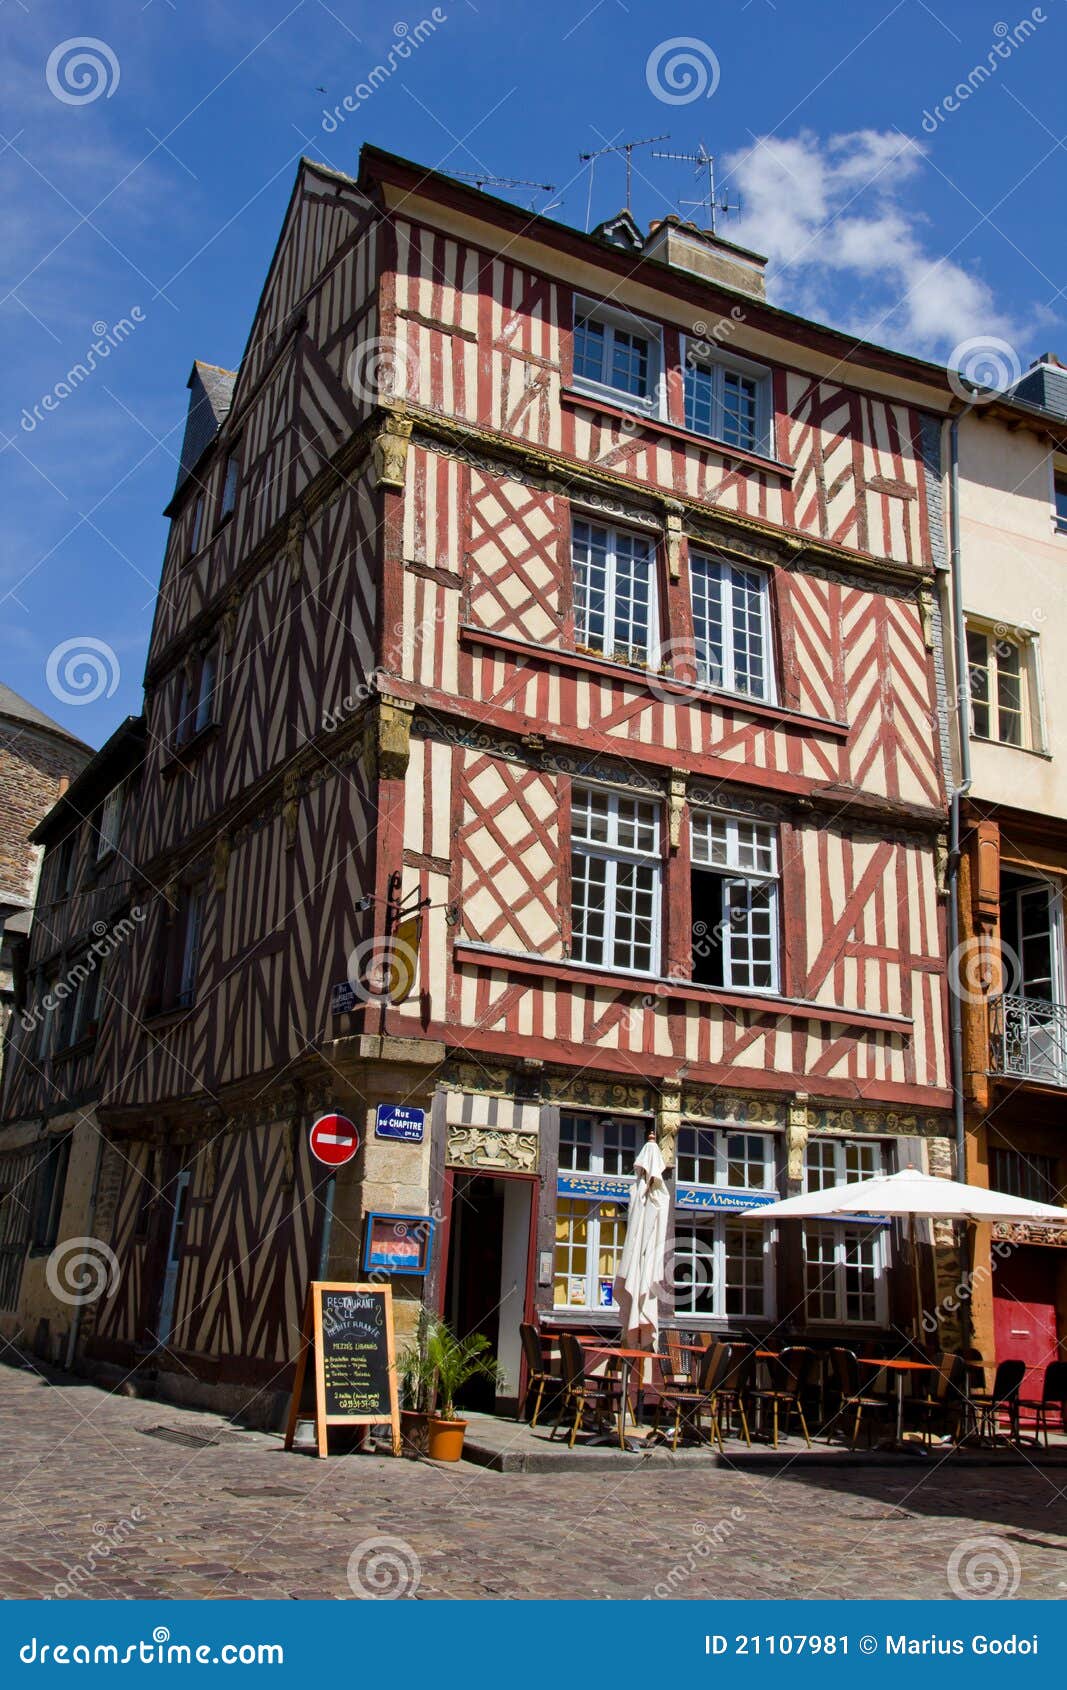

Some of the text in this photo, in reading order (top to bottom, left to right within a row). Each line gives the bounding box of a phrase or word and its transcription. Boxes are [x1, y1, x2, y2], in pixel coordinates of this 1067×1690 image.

[389, 1118, 423, 1131] CHAPITRE
[327, 1297, 376, 1309] RESTAURANT
[344, 1310, 354, 1319] LE
